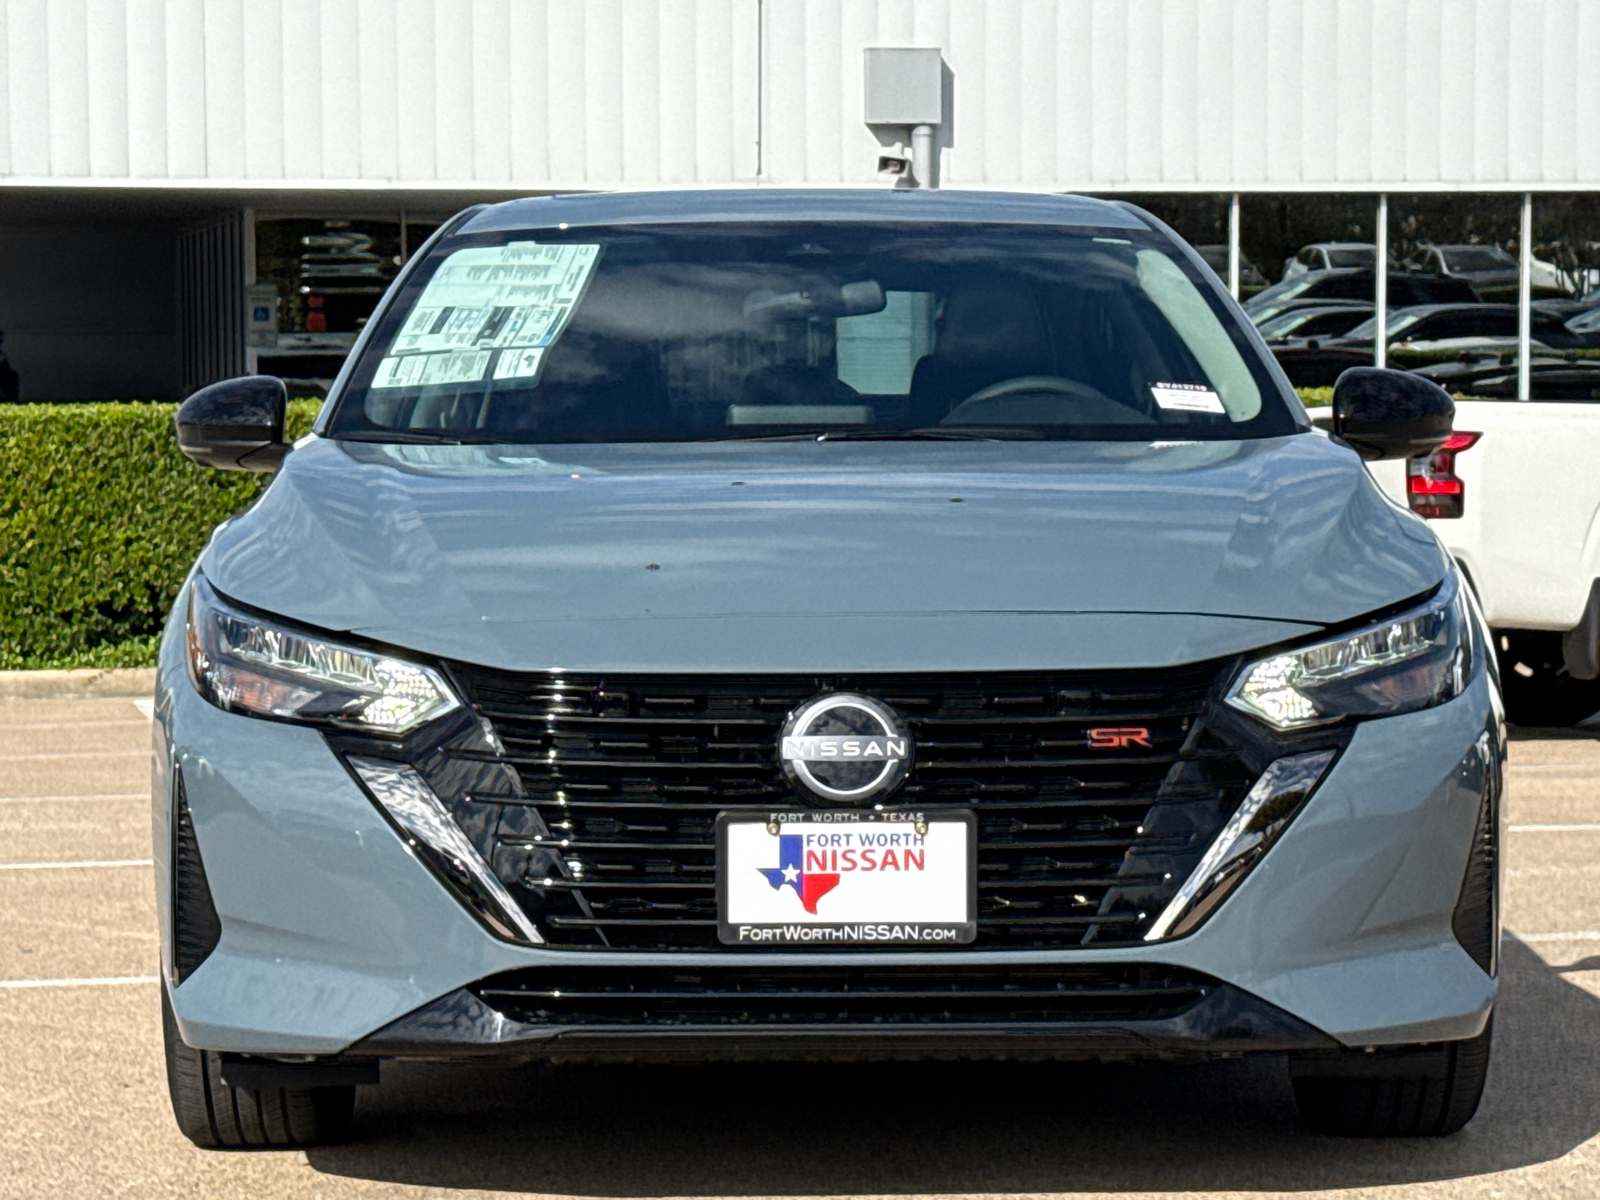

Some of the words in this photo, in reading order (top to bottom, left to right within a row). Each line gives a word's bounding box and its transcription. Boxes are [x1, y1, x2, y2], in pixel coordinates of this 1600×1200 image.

[1089, 727, 1152, 748] SR
[786, 740, 905, 757] NISSAN
[770, 812, 805, 823] FORT
[811, 812, 860, 823] WORTH
[881, 812, 925, 822] TEXAS
[806, 833, 853, 847] FORT
[859, 832, 925, 847] WORTH
[806, 848, 925, 872] NISSAN
